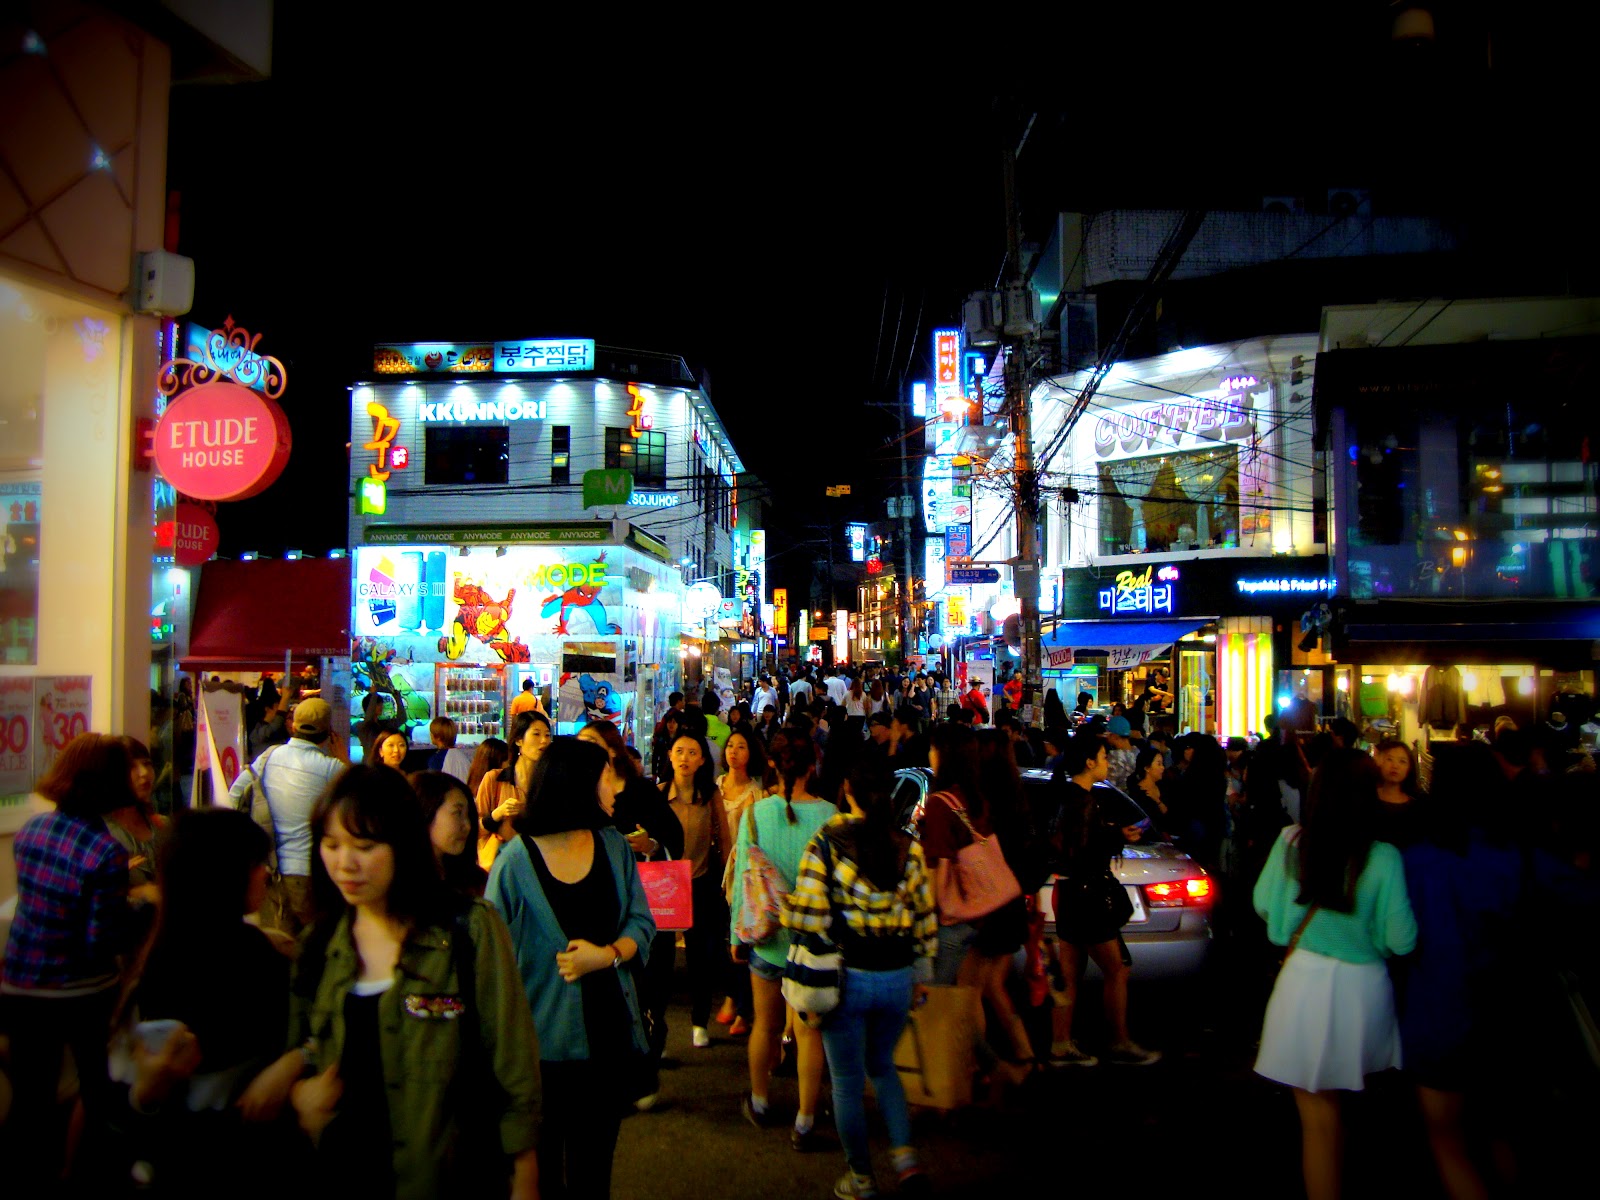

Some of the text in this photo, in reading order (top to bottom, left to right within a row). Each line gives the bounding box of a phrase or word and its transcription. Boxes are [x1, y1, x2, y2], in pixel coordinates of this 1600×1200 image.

[501, 345, 589, 367] 봉추찜닭
[419, 401, 547, 421] KKUNNORI
[1095, 393, 1246, 447] COFFEE
[170, 417, 258, 449] ETUDE
[182, 449, 244, 468] HOUSE
[605, 474, 625, 494] M
[175, 521, 210, 541] TUDE
[370, 531, 600, 541] ANYMODE ANYMODE ANYMODE ANYMODE ANYMODE
[177, 538, 203, 551] OUSE
[360, 583, 414, 596] GALAXY
[419, 582, 428, 596] S
[1116, 565, 1152, 595] Real
[1099, 584, 1172, 614] 미스테리
[0, 756, 27, 771] ALE
